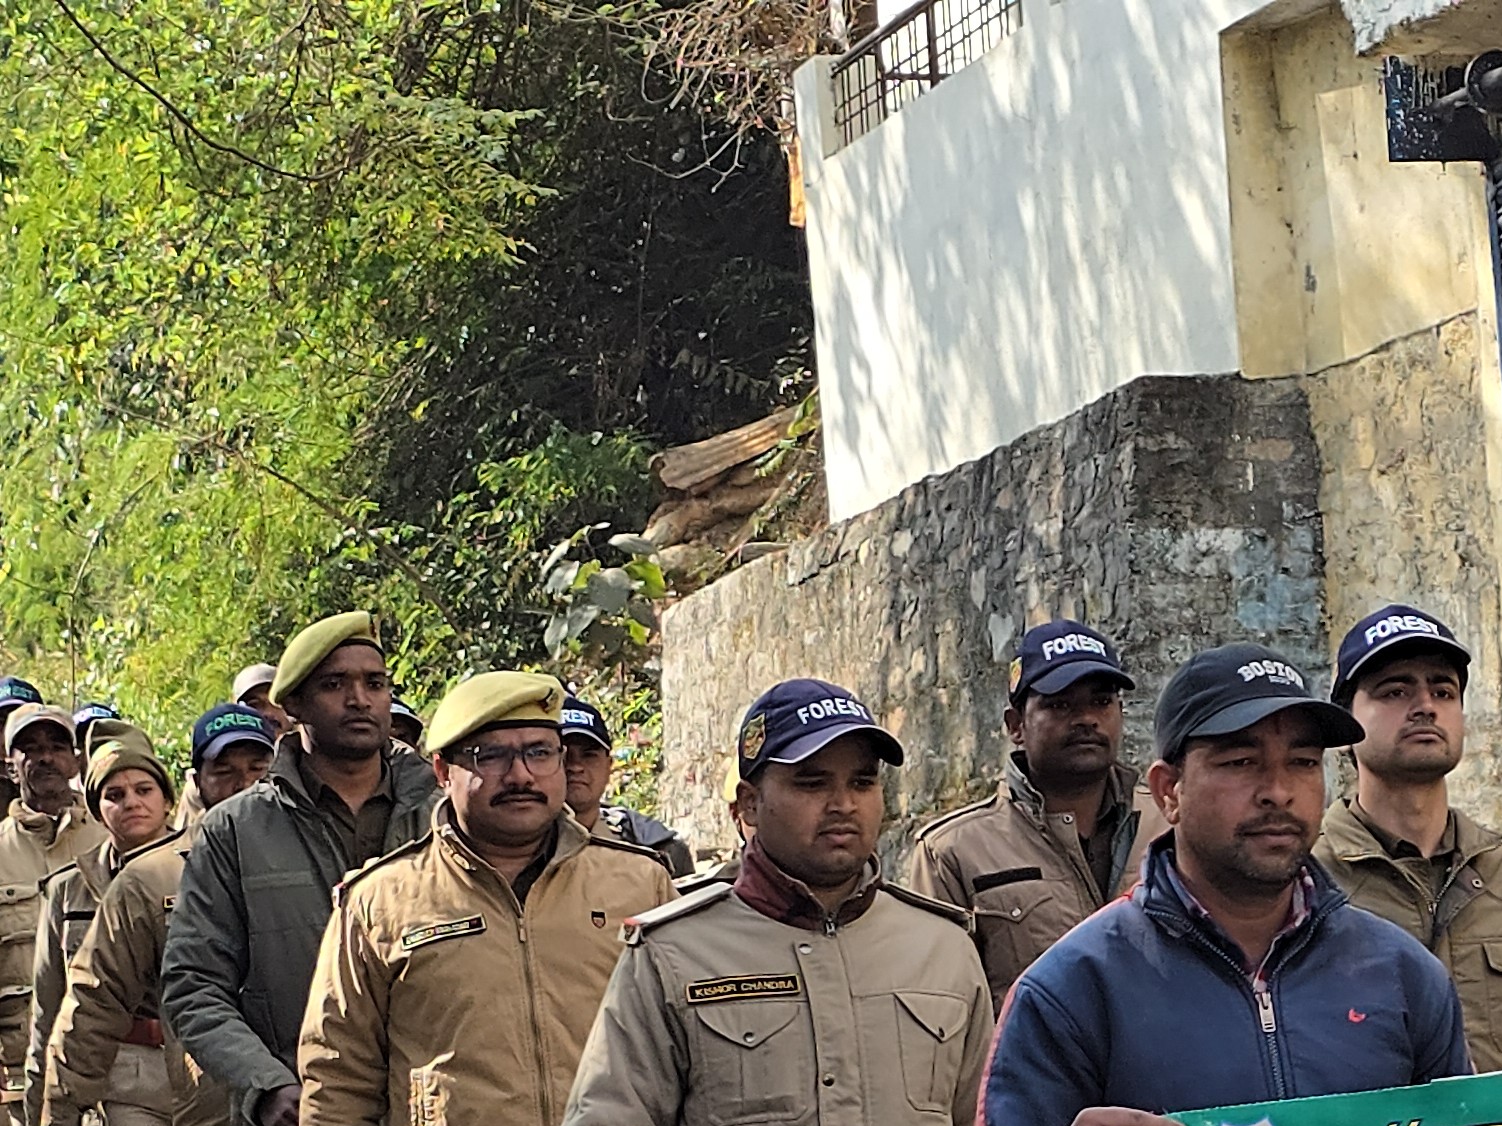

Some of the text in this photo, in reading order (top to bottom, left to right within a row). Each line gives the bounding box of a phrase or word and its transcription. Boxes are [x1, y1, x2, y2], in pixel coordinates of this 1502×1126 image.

[1365, 615, 1440, 646] FOREST
[1042, 633, 1106, 660] FOREST
[797, 698, 869, 724] FOREST
[205, 713, 263, 737] FOREST
[695, 980, 795, 998] KISHOR CHANDRA
